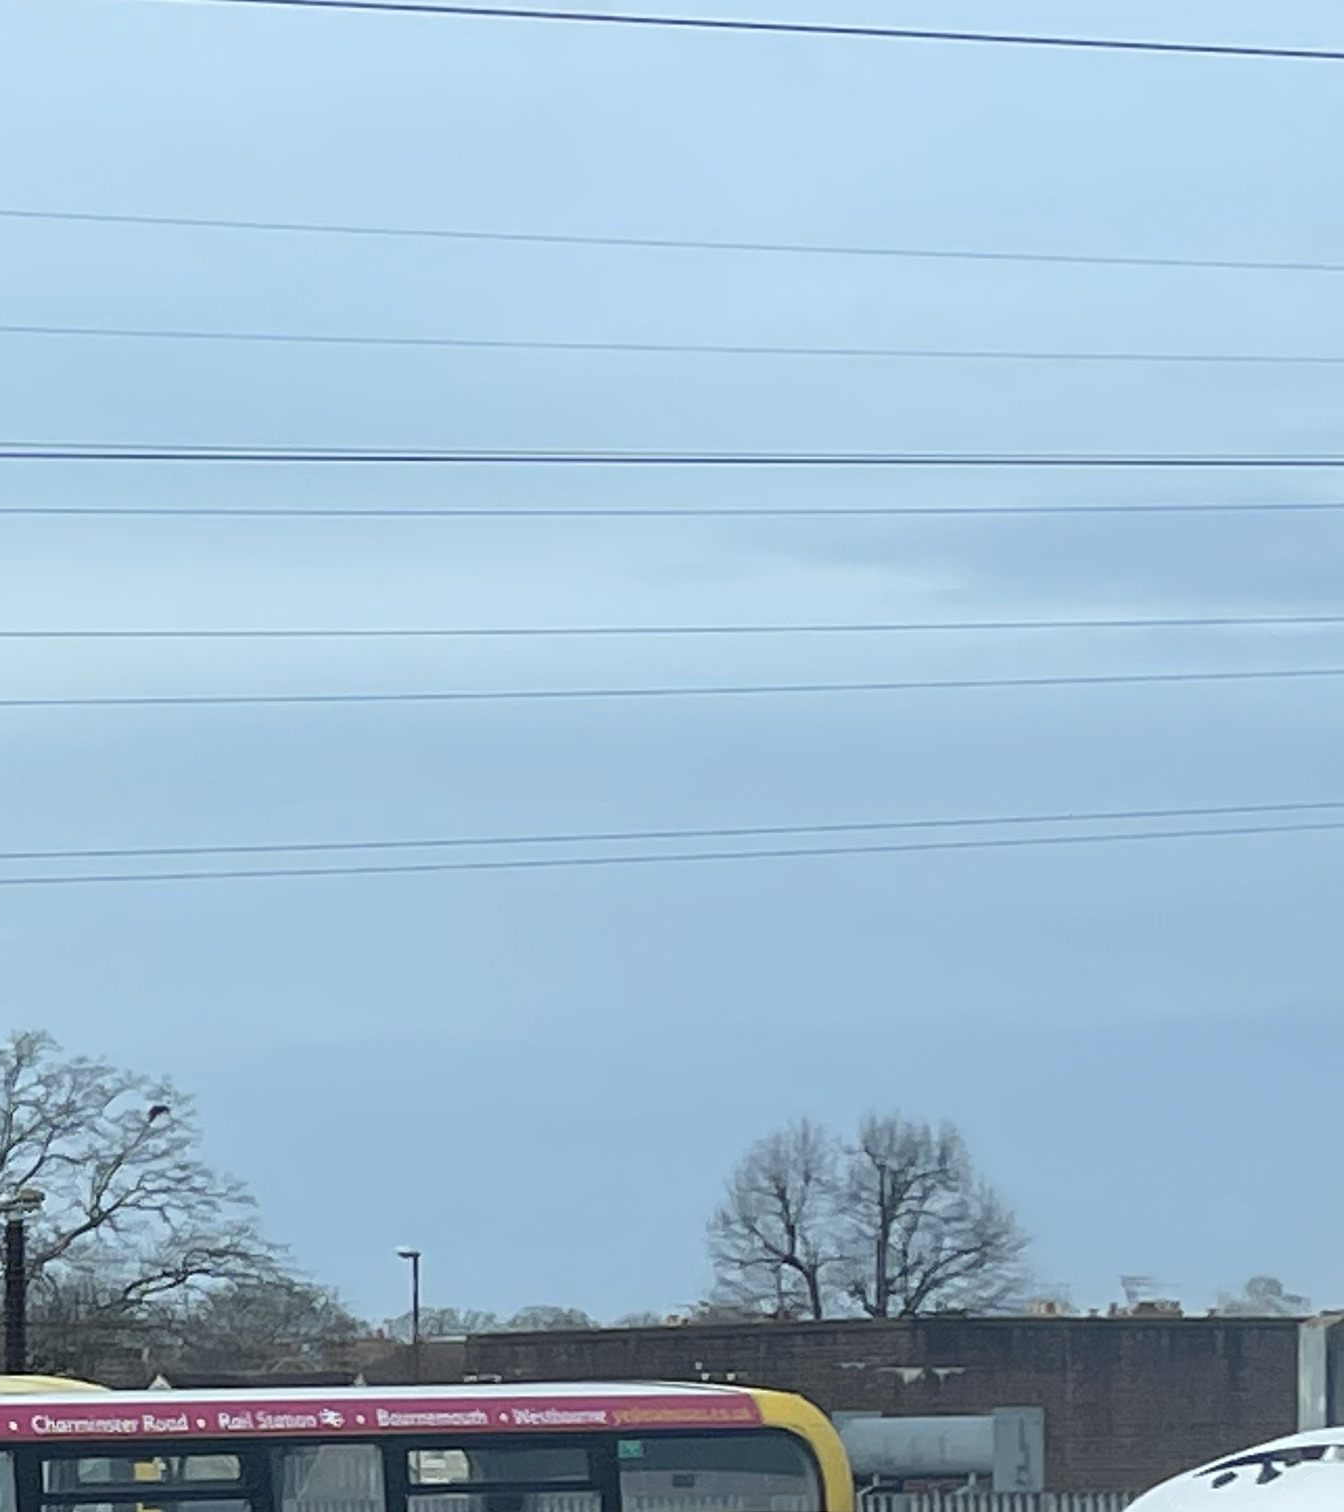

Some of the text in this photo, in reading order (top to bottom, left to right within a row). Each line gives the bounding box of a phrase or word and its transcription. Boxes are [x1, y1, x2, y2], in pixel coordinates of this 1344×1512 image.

[30, 1413, 189, 1434] Charminster Road
[217, 1410, 317, 1431] Rail Station
[376, 1408, 489, 1427] Bournemouth
[512, 1408, 608, 1426] Westbourne
